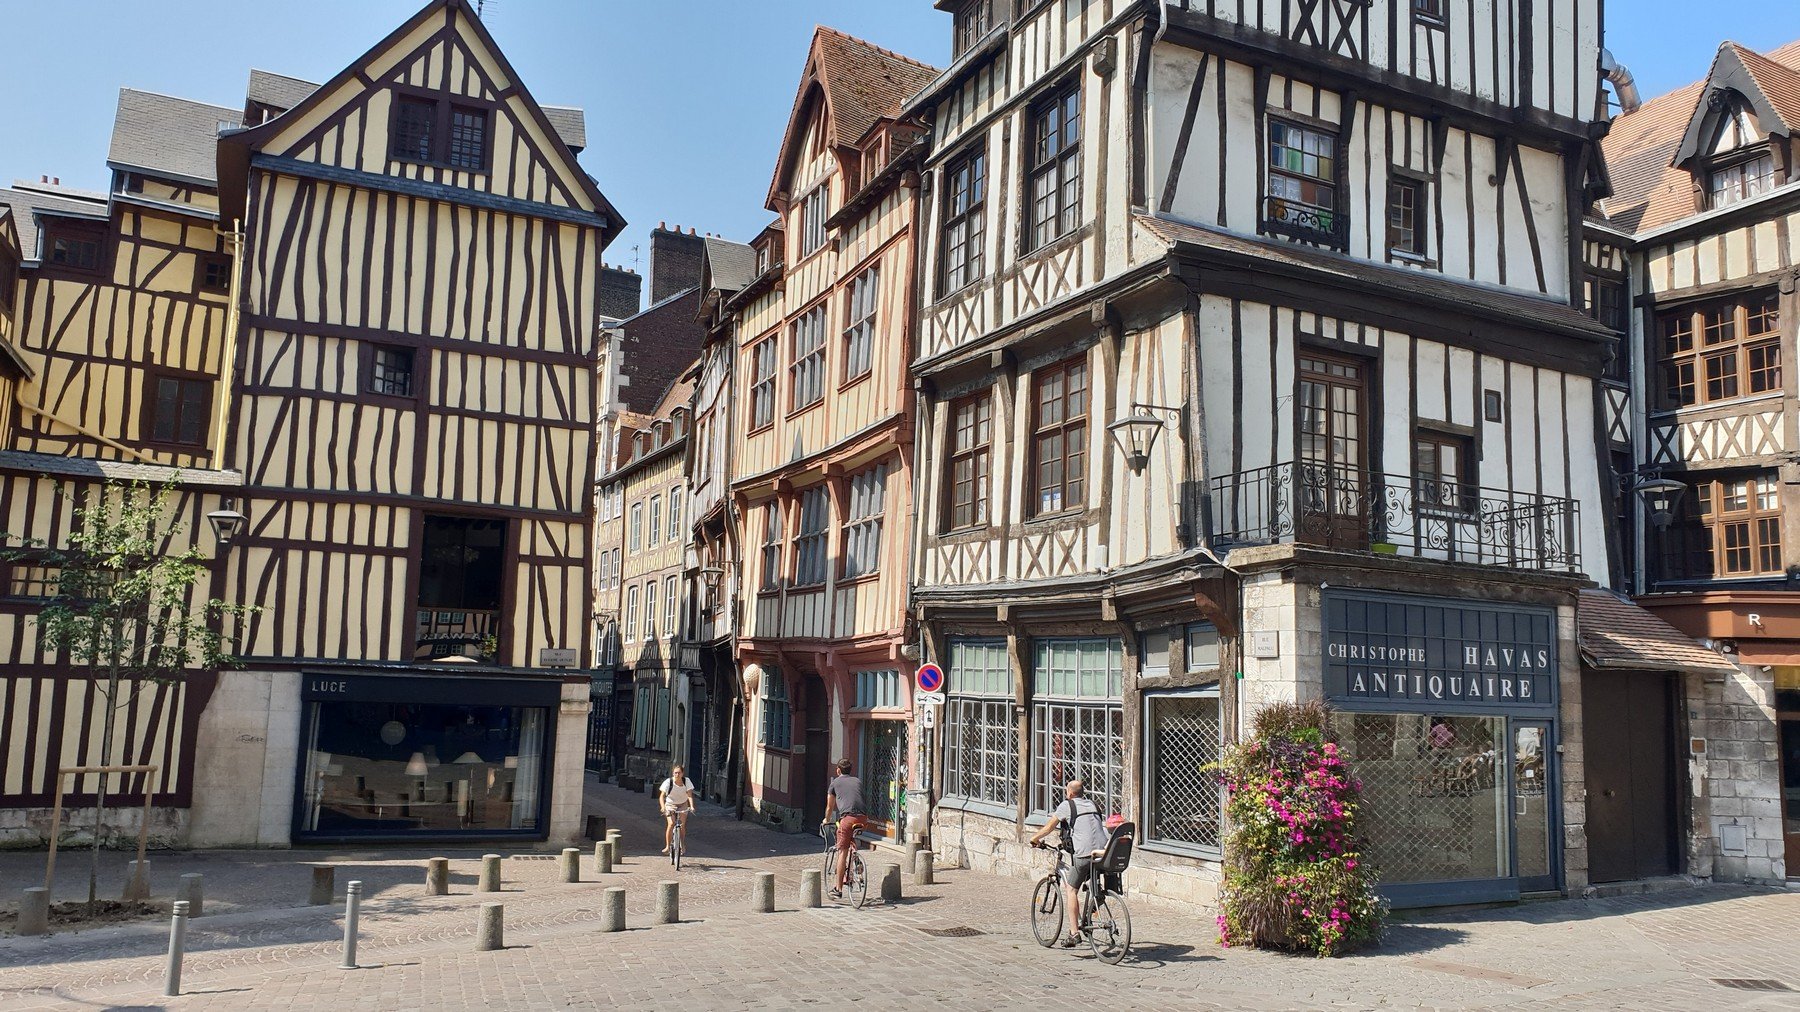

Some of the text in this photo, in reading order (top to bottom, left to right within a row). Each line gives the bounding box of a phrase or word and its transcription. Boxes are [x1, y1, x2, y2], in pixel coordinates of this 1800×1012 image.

[1748, 613, 1762, 626] R
[1328, 643, 1548, 668] CHRISTOPHE HAVAS
[311, 681, 347, 693] LUCE
[1352, 672, 1532, 699] ANTIQUAIRE
